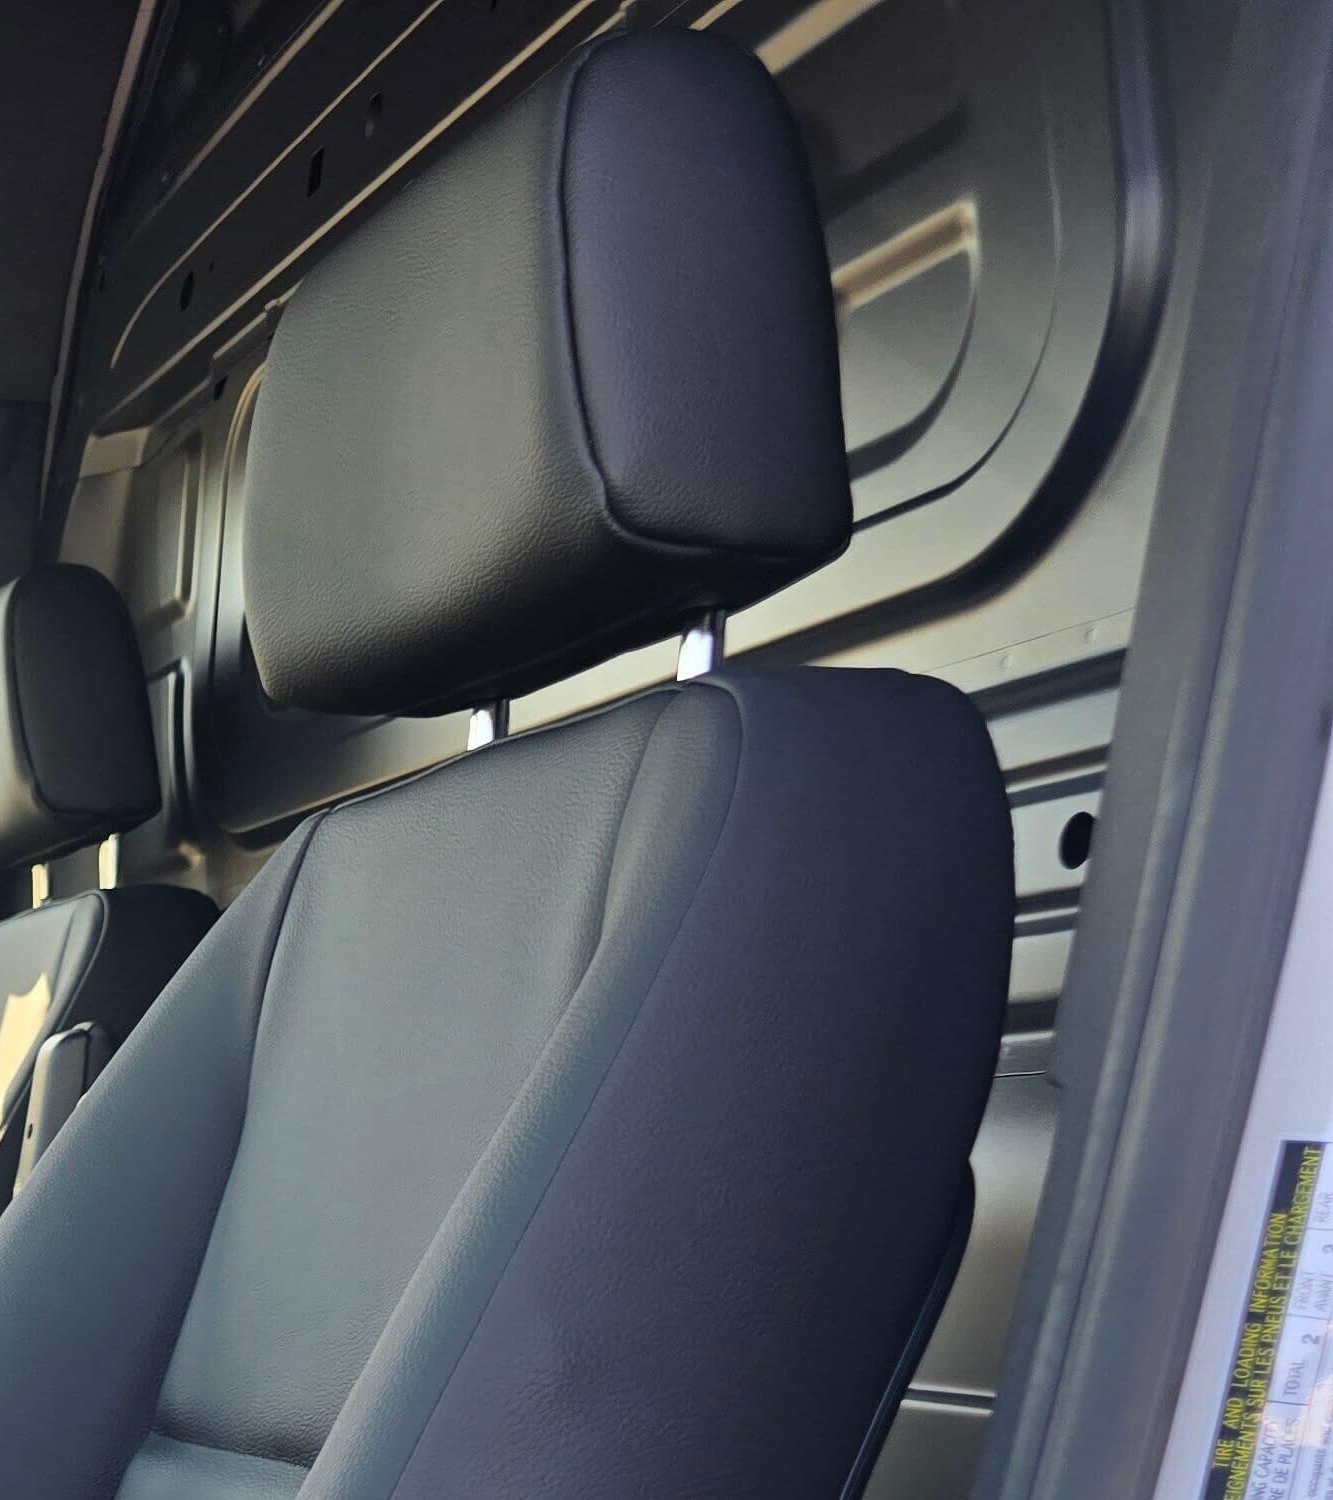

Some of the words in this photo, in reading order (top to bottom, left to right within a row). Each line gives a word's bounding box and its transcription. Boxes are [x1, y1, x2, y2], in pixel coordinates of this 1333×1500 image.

[1284, 1146, 1322, 1246] CHARGEMENT
[1317, 1192, 1333, 1223] REAR
[1249, 1213, 1287, 1313] INFORMATION
[1277, 1250, 1297, 1269] LE
[1273, 1272, 1292, 1290] ET
[1295, 1271, 1315, 1310] FRONT
[1314, 1273, 1333, 1312] AVANT
[1260, 1296, 1286, 1343] PNEUS
[1231, 1322, 1262, 1388] LOADING
[1301, 1333, 1320, 1345] 2
[1253, 1348, 1275, 1375] LES
[1246, 1379, 1268, 1408] SUR
[1283, 1361, 1304, 1396] TOTAL
[1223, 1397, 1244, 1430] AND
[1213, 1439, 1234, 1468] TIRE
[1277, 1418, 1298, 1465] PLACES
[1273, 1467, 1290, 1484] DE
